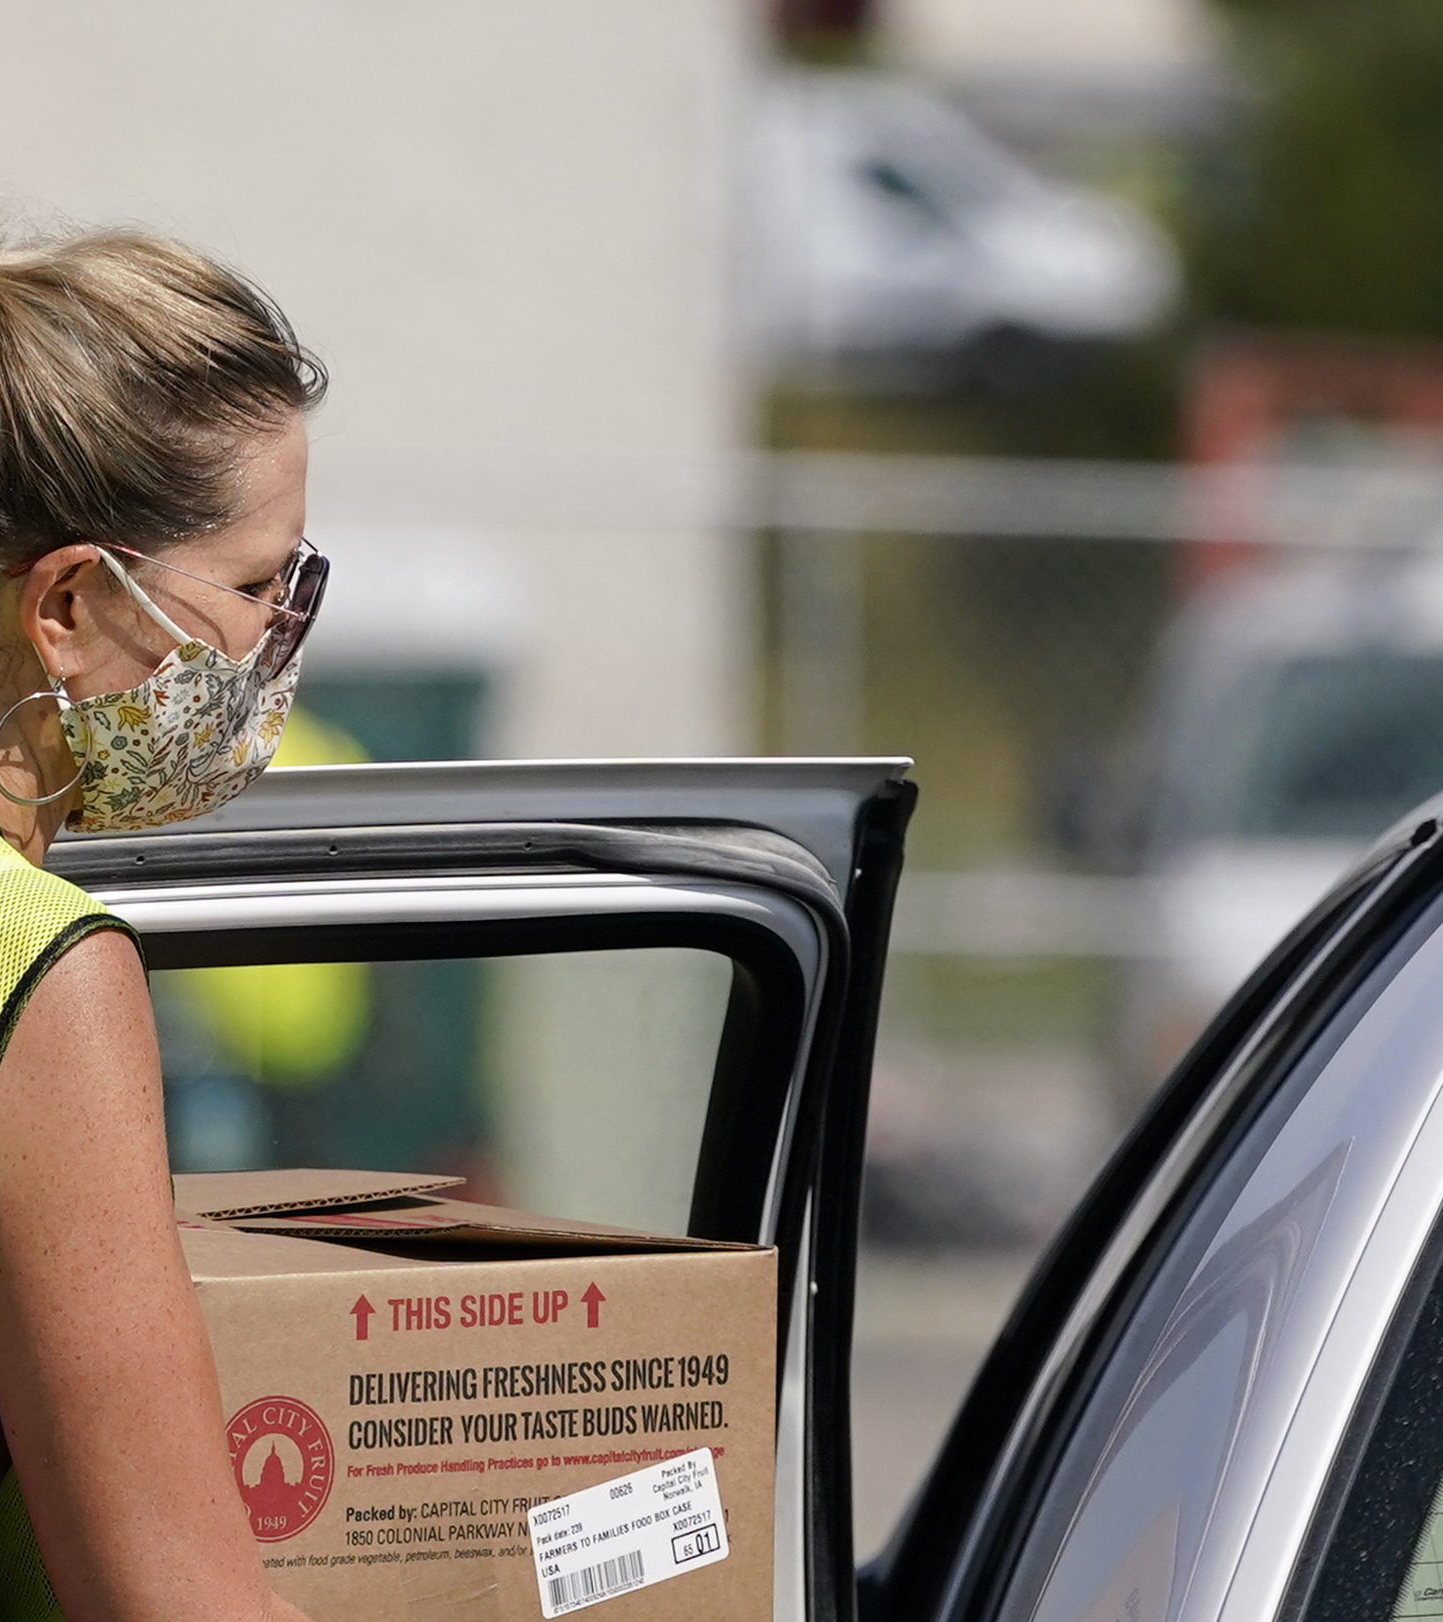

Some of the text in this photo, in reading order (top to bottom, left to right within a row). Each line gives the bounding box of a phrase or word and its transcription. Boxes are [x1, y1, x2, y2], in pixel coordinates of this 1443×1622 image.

[388, 1290, 568, 1331] THIS SIDE UP
[349, 1354, 729, 1405] DELIVERING FRESHNESS SINCE 1949
[348, 1400, 729, 1450] CONSIDER YOUR TASTE BUDS WARNED.
[262, 1406, 327, 1518] CITY FRUIT
[347, 1465, 363, 1478] For
[366, 1463, 394, 1477] Fresh
[397, 1461, 438, 1475] Produce
[440, 1458, 485, 1474] Handling
[487, 1456, 534, 1471] Practices
[537, 1457, 549, 1469] go
[551, 1455, 561, 1466] to
[661, 1463, 686, 1478] Packed
[652, 1480, 677, 1494] Capital
[345, 1505, 395, 1522] Packed
[398, 1503, 418, 1522] by:
[420, 1500, 477, 1519] CAPITAL
[480, 1498, 510, 1516] CITY
[257, 1515, 287, 1531] 1949
[539, 1500, 693, 1562] FARMERS TO FAMILIES FOOD BOX CASE
[345, 1529, 373, 1547] 1850
[377, 1526, 445, 1545] COLONIAL
[448, 1523, 514, 1542] PARKWAY
[695, 1533, 712, 1554] 01
[286, 1553, 306, 1566] with
[308, 1553, 328, 1566] food
[330, 1553, 356, 1567] grade
[541, 1564, 561, 1578] USA
